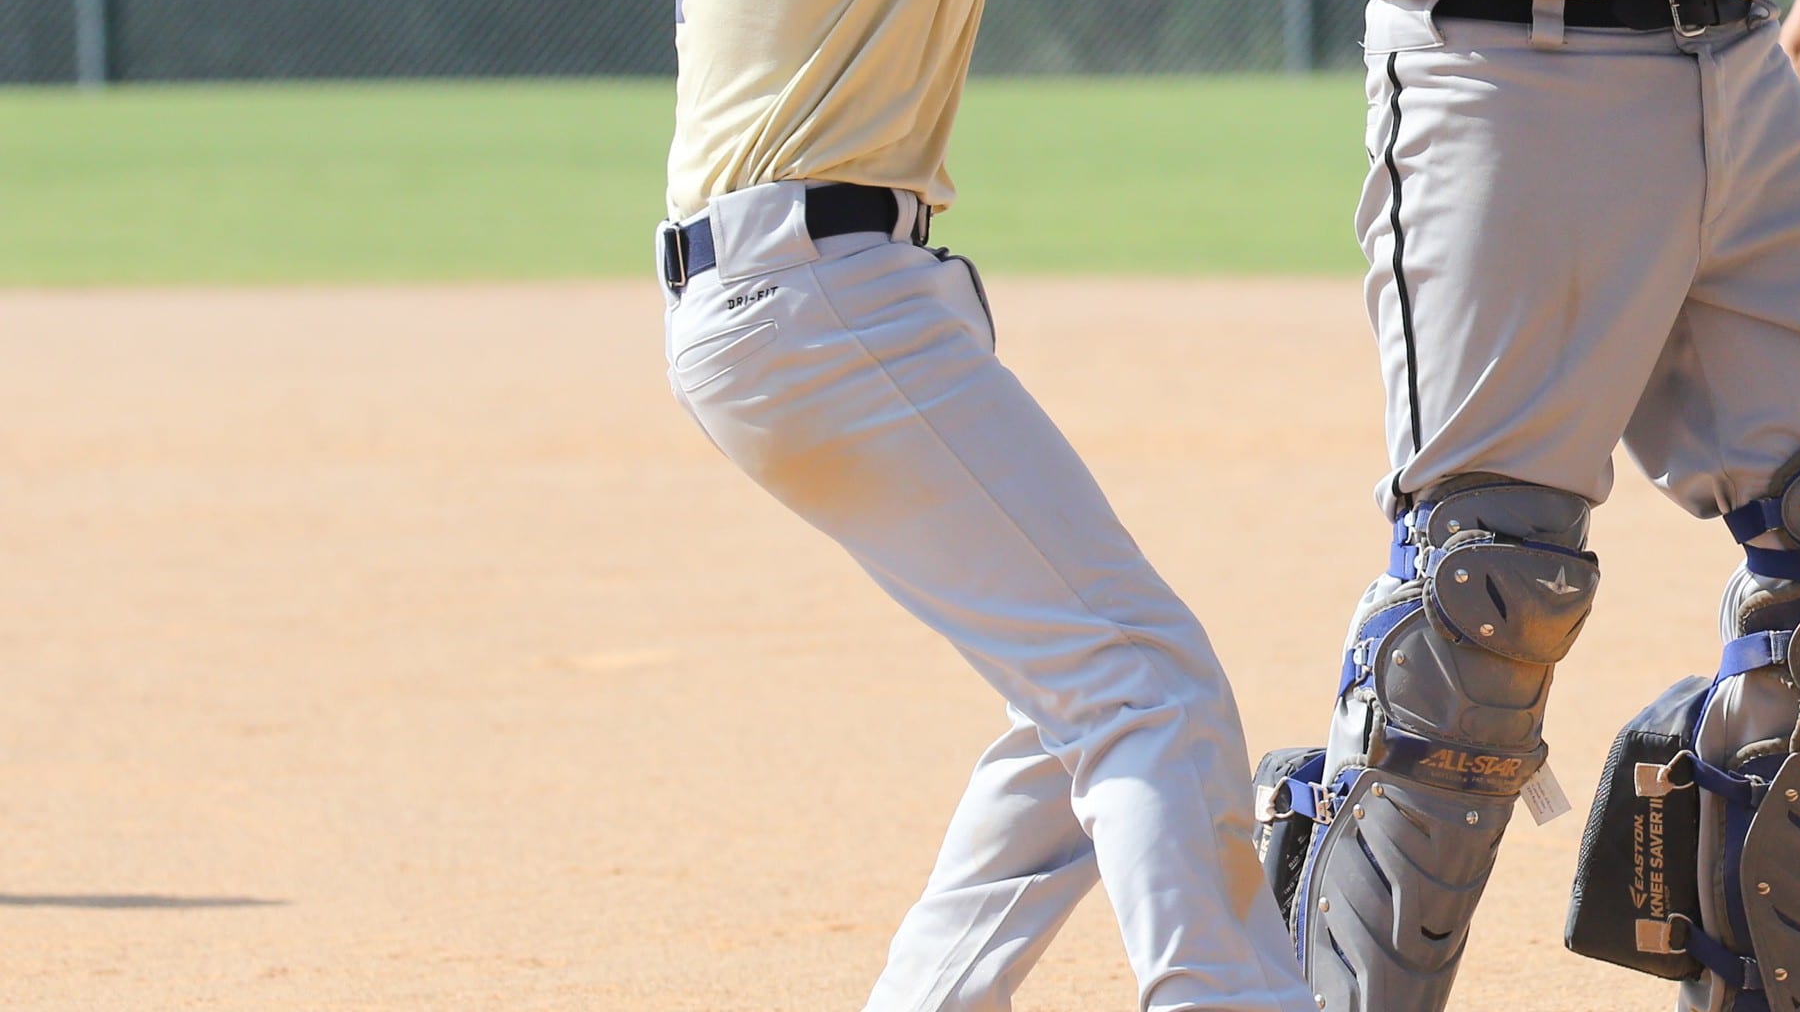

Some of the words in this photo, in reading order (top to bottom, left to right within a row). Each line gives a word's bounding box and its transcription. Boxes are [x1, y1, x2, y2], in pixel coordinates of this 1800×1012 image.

[727, 286, 779, 309] DRI-FIT
[1419, 748, 1522, 777] ALL-STAR
[1633, 814, 1645, 891] EASTON
[1650, 811, 1665, 869] SAVER
[1651, 871, 1665, 918] KNEE
